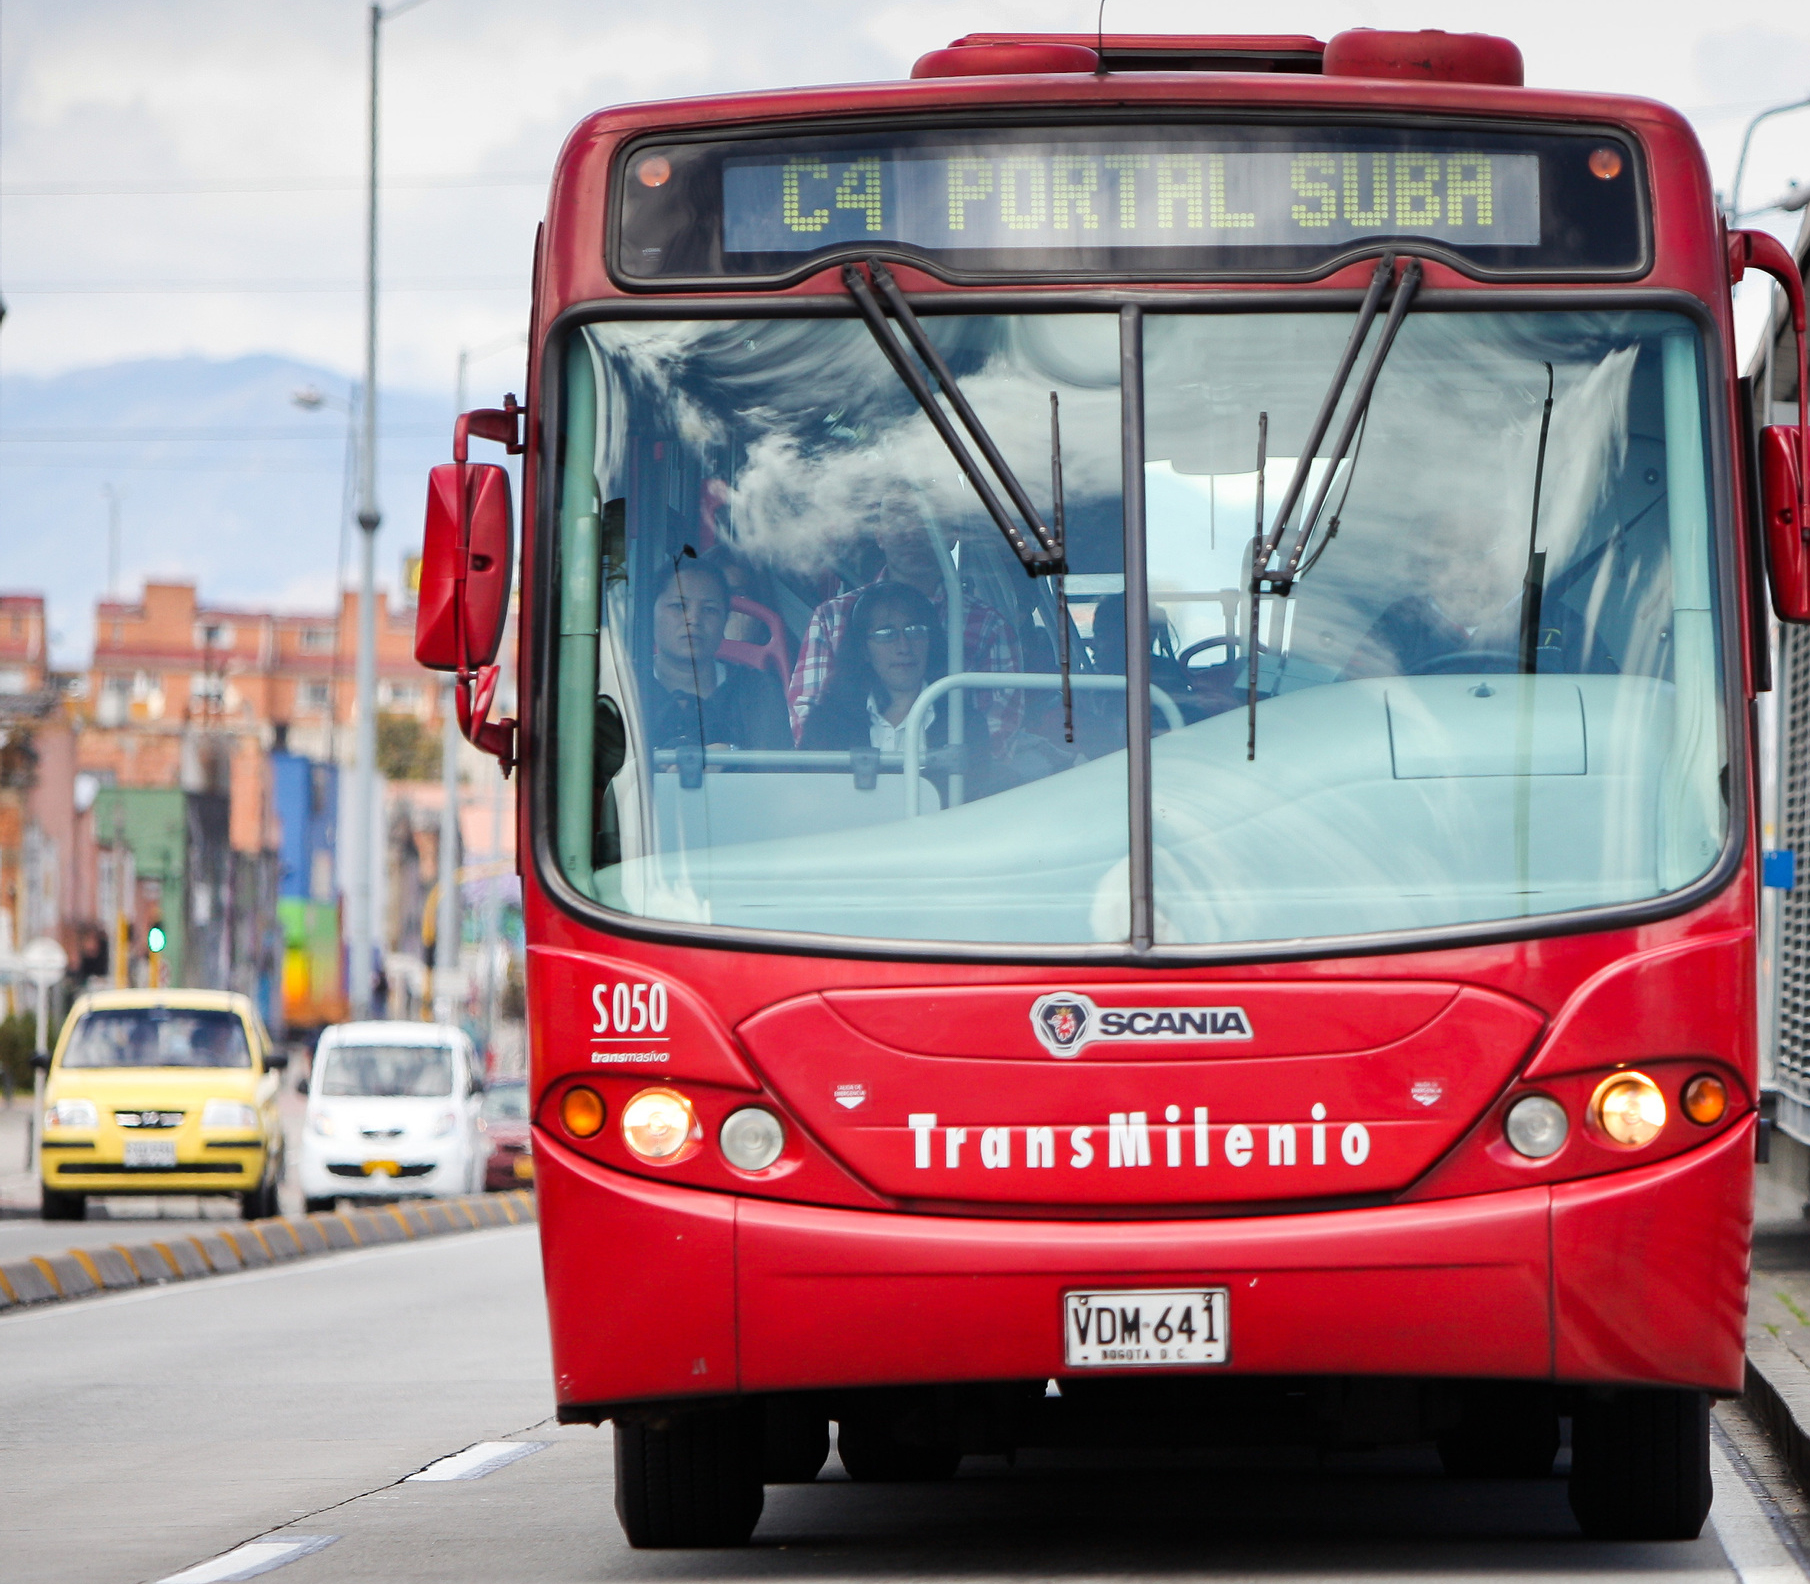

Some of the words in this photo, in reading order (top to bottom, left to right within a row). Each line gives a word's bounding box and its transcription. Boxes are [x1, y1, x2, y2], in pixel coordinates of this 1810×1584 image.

[782, 156, 883, 232] C4
[948, 153, 1256, 230] PORTAL
[1290, 150, 1495, 228] SUBA
[1099, 1011, 1247, 1036] SCANIA
[591, 1050, 670, 1063] transmasivo
[907, 1101, 1371, 1170] TransMilenio
[1101, 1348, 1151, 1362] BOGOTA
